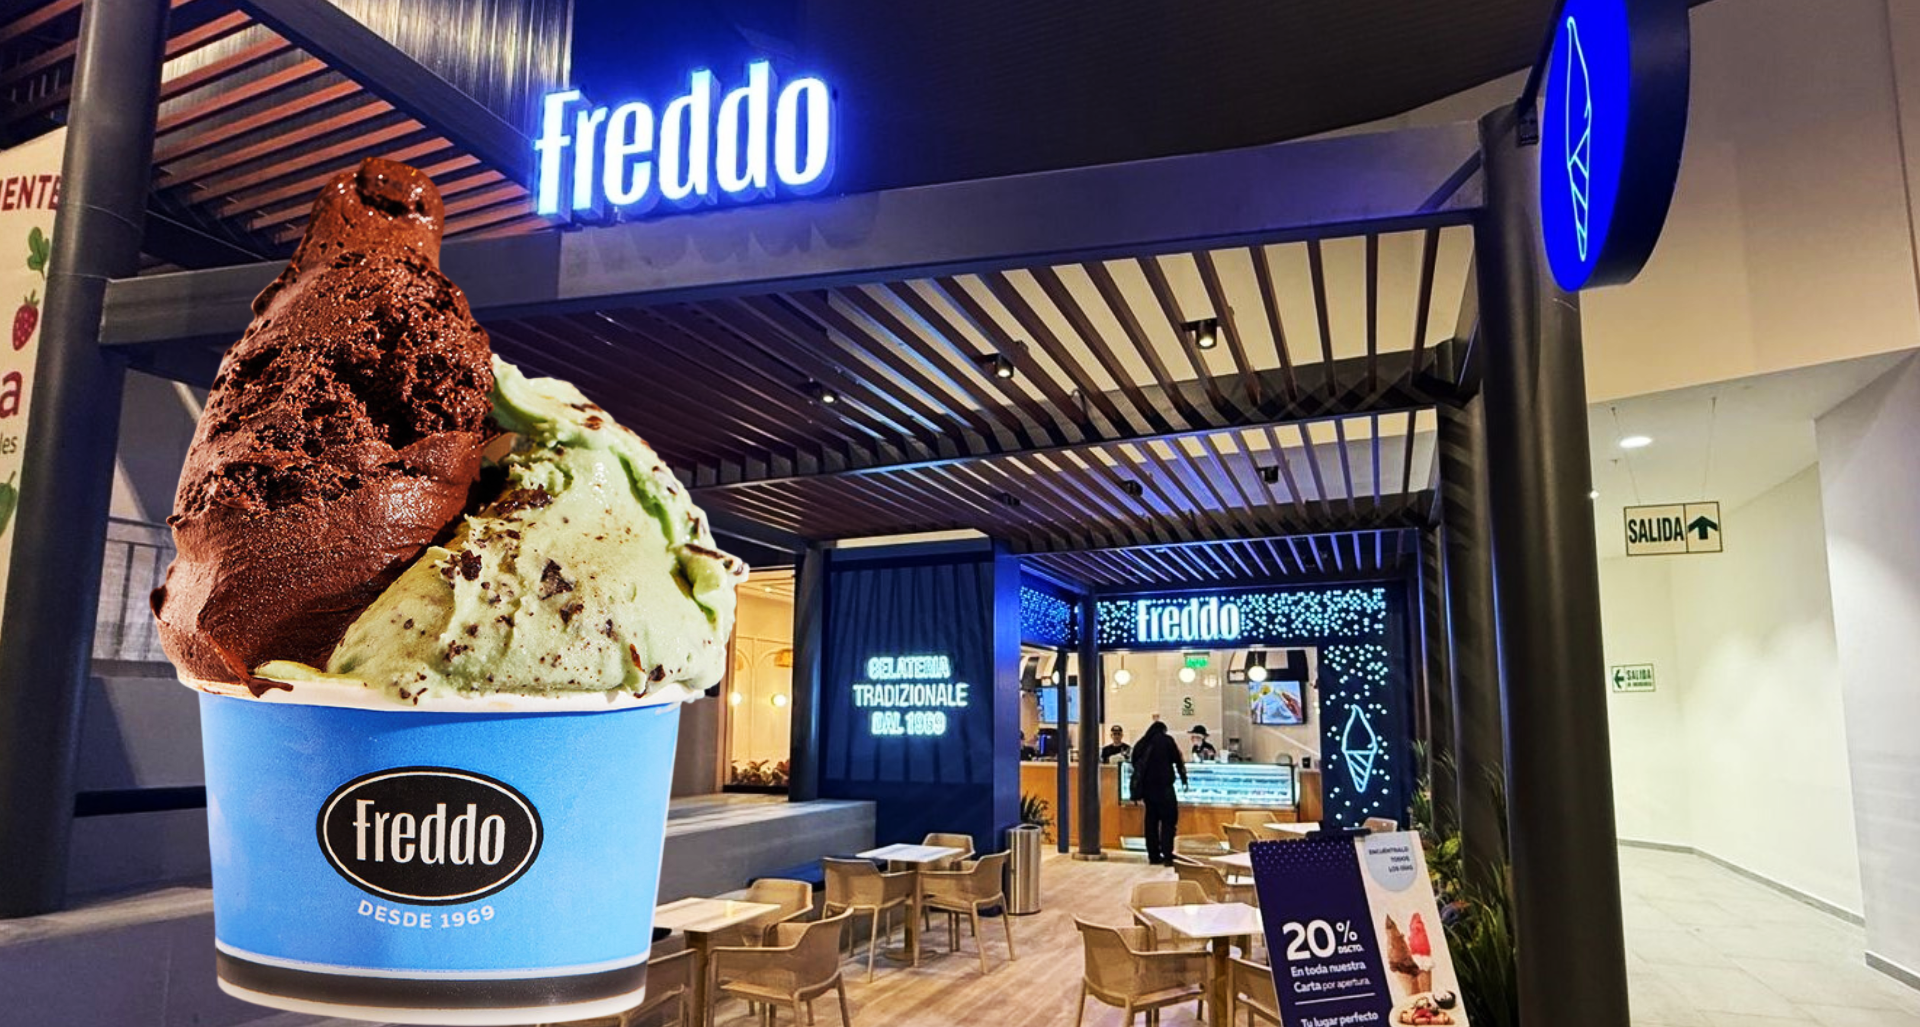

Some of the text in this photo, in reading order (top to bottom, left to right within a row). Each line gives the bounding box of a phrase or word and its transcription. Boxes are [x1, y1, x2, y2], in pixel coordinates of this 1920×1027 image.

[534, 60, 832, 216] freddo
[0, 174, 61, 210] ENTE
[1628, 517, 1684, 543] SALIDA
[1135, 597, 1240, 641] freddo
[1627, 669, 1651, 680] SALIDA
[852, 682, 970, 707] TRADIZIONALE
[871, 711, 946, 735] DAL 1969
[352, 799, 506, 866] freddo
[357, 900, 495, 929] DESDE 1969
[1290, 961, 1367, 977] En toda nuestra
[1293, 981, 1321, 993] Carta
[1322, 982, 1336, 991] por
[1313, 1016, 1338, 1027] lugar
[1339, 1012, 1379, 1027] perfecto
